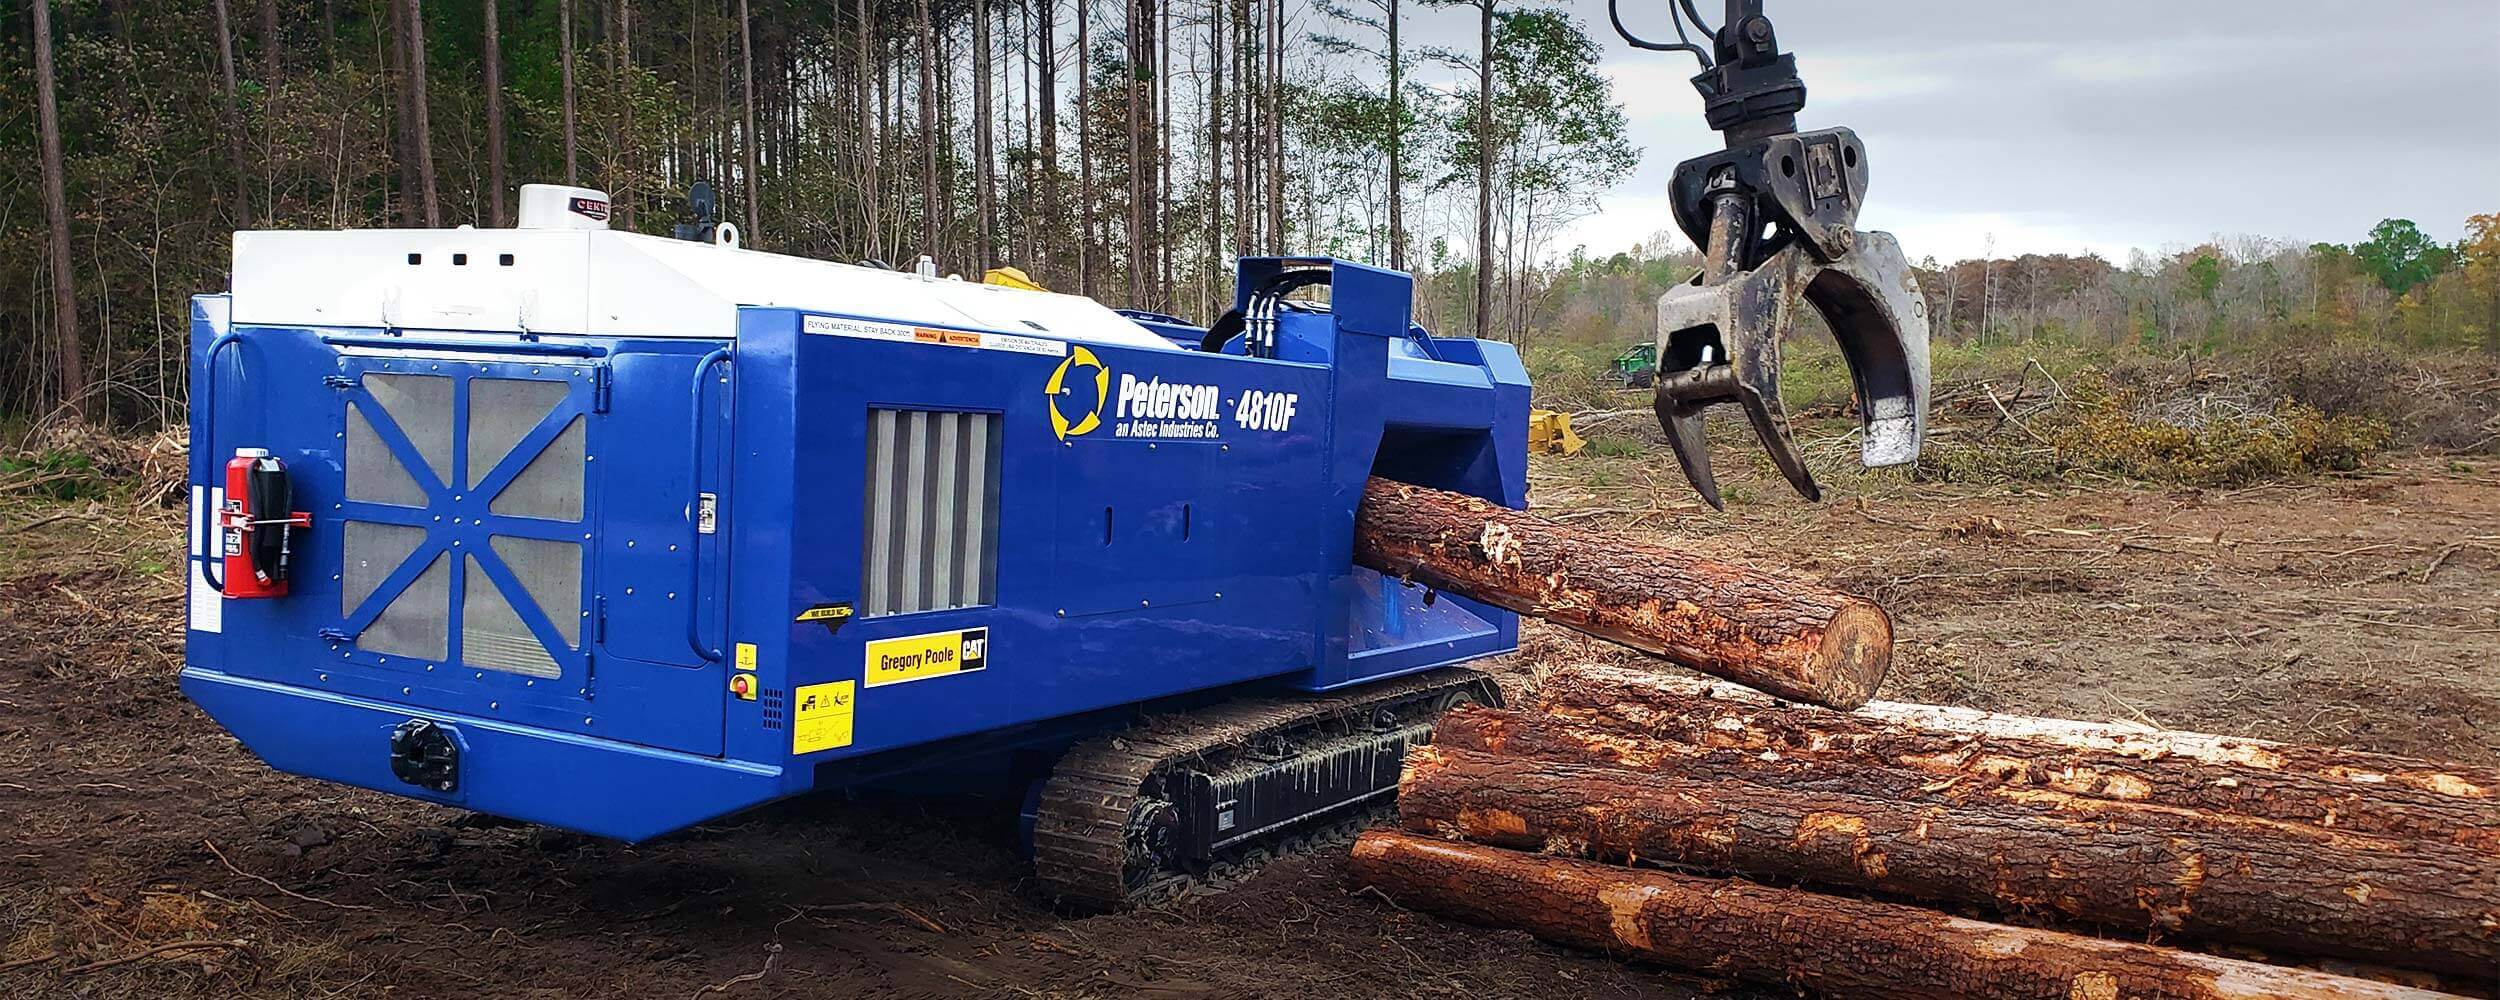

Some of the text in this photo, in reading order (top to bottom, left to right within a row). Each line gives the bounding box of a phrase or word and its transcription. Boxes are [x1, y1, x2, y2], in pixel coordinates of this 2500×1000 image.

[807, 321, 830, 330] FLYING
[831, 323, 862, 333] MATERIAL
[863, 326, 879, 334] STAY
[880, 328, 896, 336] BACK
[915, 332, 937, 340] WARNING
[1235, 390, 1298, 432] 4810F
[1115, 420, 1220, 438] an Astec Industries Co.
[881, 646, 954, 671] Gregory Poole
[962, 638, 985, 661] CAT
